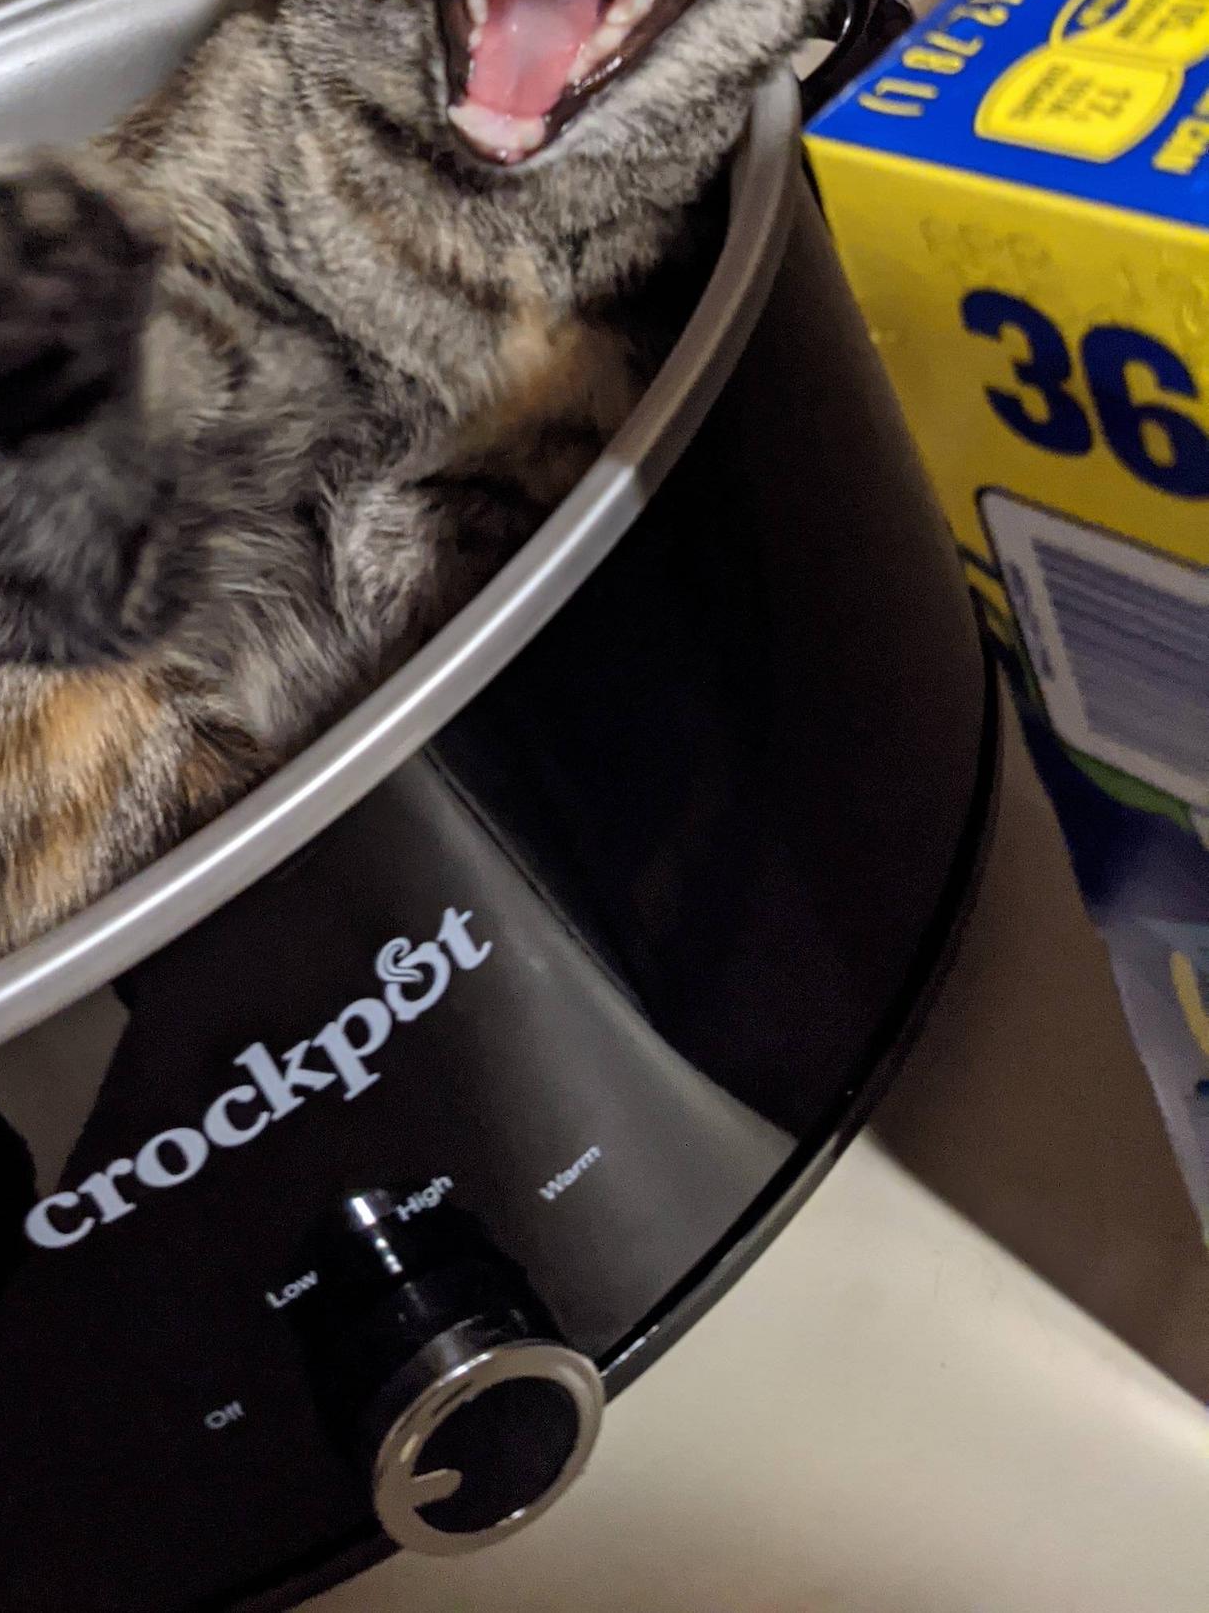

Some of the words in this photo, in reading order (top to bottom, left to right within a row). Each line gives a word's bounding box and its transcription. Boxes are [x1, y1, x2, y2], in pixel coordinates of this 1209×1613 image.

[958, 288, 1209, 501] 36
[538, 1144, 601, 1201] Warm
[395, 1173, 453, 1222] High
[265, 1269, 318, 1309] Low
[203, 1400, 245, 1431] Off
